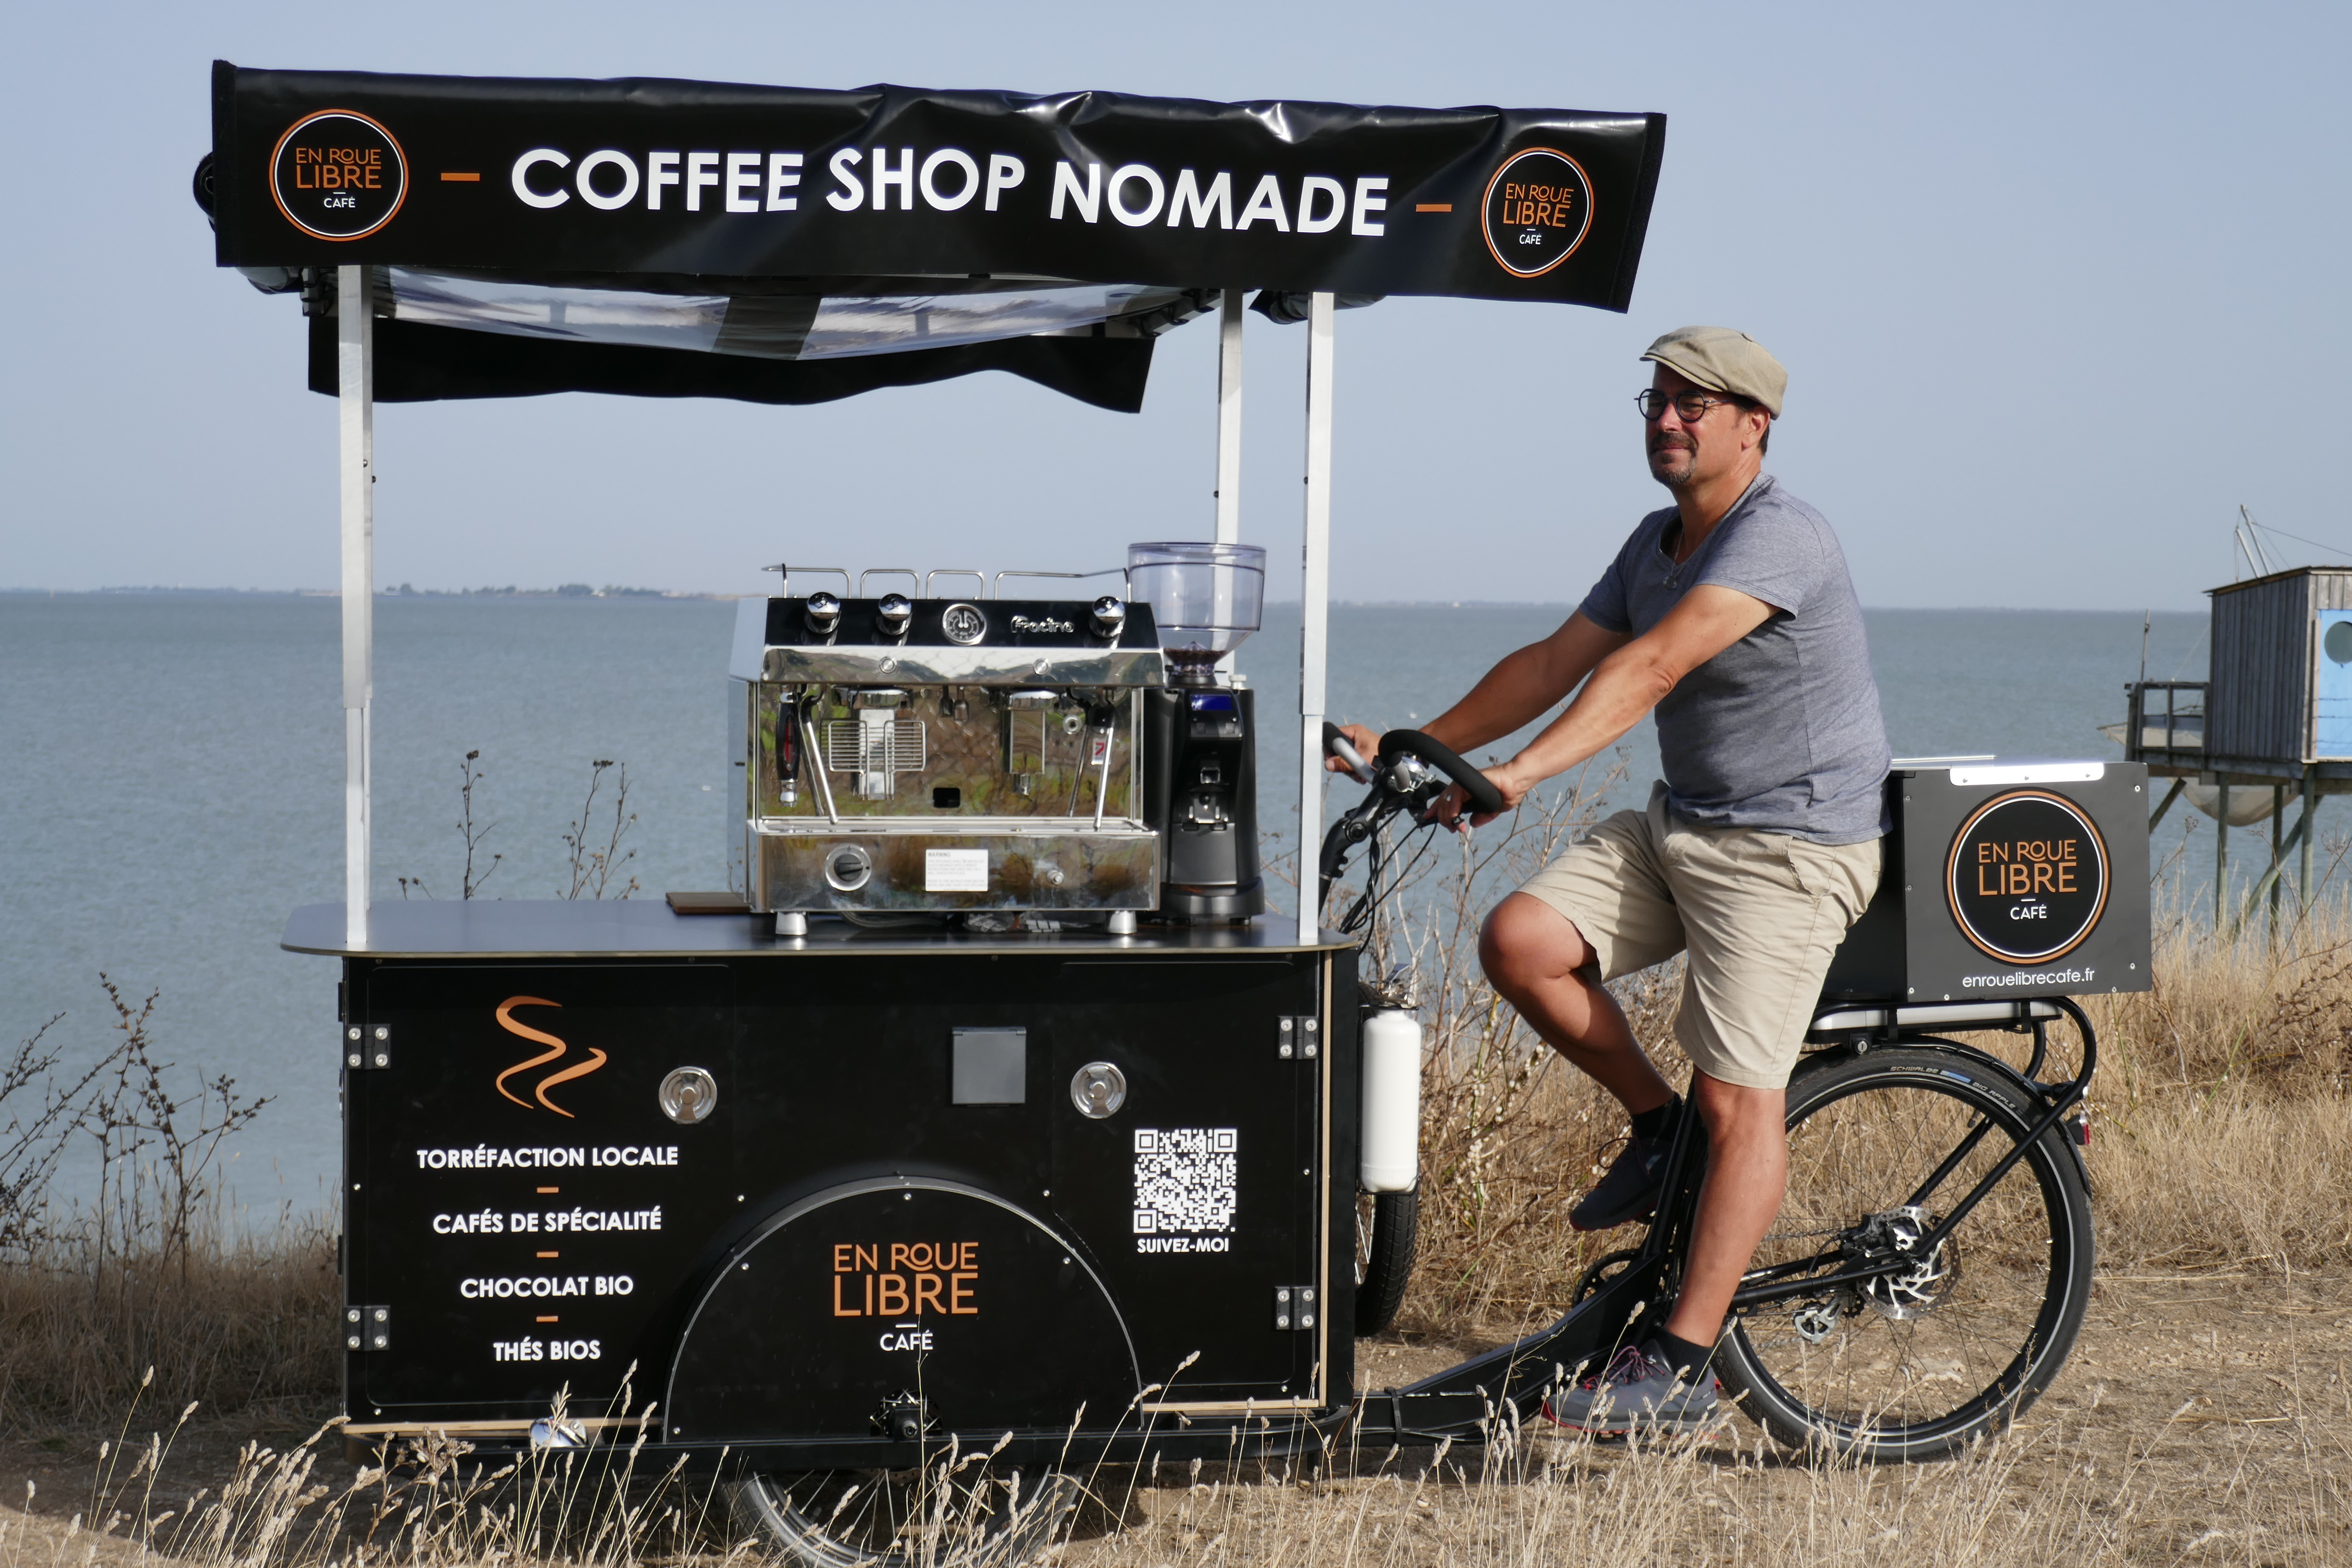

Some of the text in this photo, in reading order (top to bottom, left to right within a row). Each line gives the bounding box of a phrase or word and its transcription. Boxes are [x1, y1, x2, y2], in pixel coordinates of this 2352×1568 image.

[296, 147, 381, 165] EN ROUE
[296, 165, 382, 189] LIBRE
[324, 196, 355, 208] CAFÉ
[511, 146, 1389, 236] COFFEE SHOP NOMADE
[1506, 183, 1574, 203] EN ROUE
[1503, 200, 1570, 227] LIBRE
[1519, 233, 1542, 245] CAFÉ
[1011, 615, 1075, 633] Fracino
[1978, 839, 2076, 862] EN ROUE
[1978, 862, 2077, 896] LIBRE
[2010, 903, 2047, 920] CAFÉ
[1962, 967, 2095, 988] enrouelibrecafe.fr
[1972, 1082, 1988, 1091] BIG
[1989, 1090, 2016, 1109] APPLE
[416, 1143, 678, 1169] TORRÉFACTION LOCALE
[433, 1205, 662, 1234] CAFÉS DE SPÉCIALITÉ
[1137, 1237, 1229, 1253] SUIVEZ-MOI
[834, 1242, 979, 1272] EN ROUE
[460, 1275, 634, 1298] CHOCOLAT BIO
[834, 1272, 979, 1317] LIBRE
[493, 1336, 601, 1361] THÉS BIOS
[879, 1329, 933, 1351] CAFÉ
